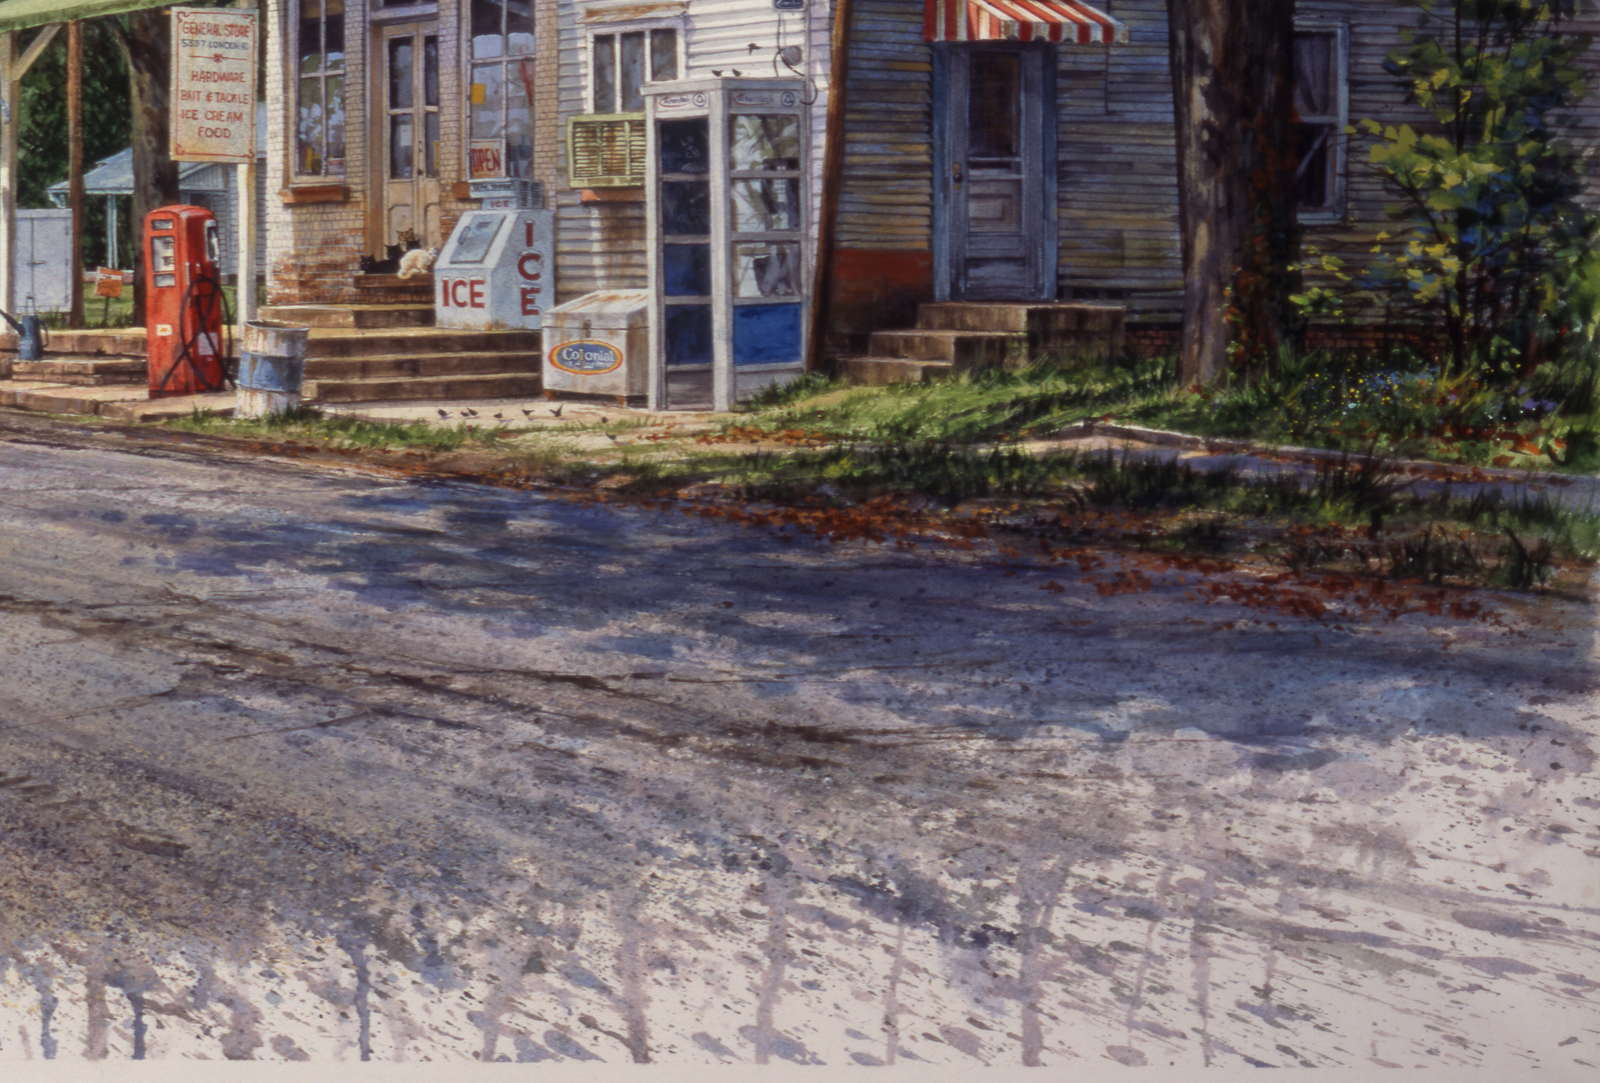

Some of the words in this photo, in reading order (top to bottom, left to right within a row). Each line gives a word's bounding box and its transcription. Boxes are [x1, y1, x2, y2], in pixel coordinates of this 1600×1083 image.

[182, 21, 222, 37] GENERAL
[224, 23, 250, 38] STORE
[191, 70, 246, 83] HARDWARE
[180, 89, 202, 102] BAIT
[215, 91, 249, 105] TACKLE
[181, 109, 199, 120] ICE
[205, 109, 244, 123] CREAM
[198, 126, 232, 139] FOOD
[470, 147, 501, 174] OPEN
[490, 200, 510, 208] ICE
[441, 276, 486, 309] ICE
[562, 347, 614, 362] Colonial
